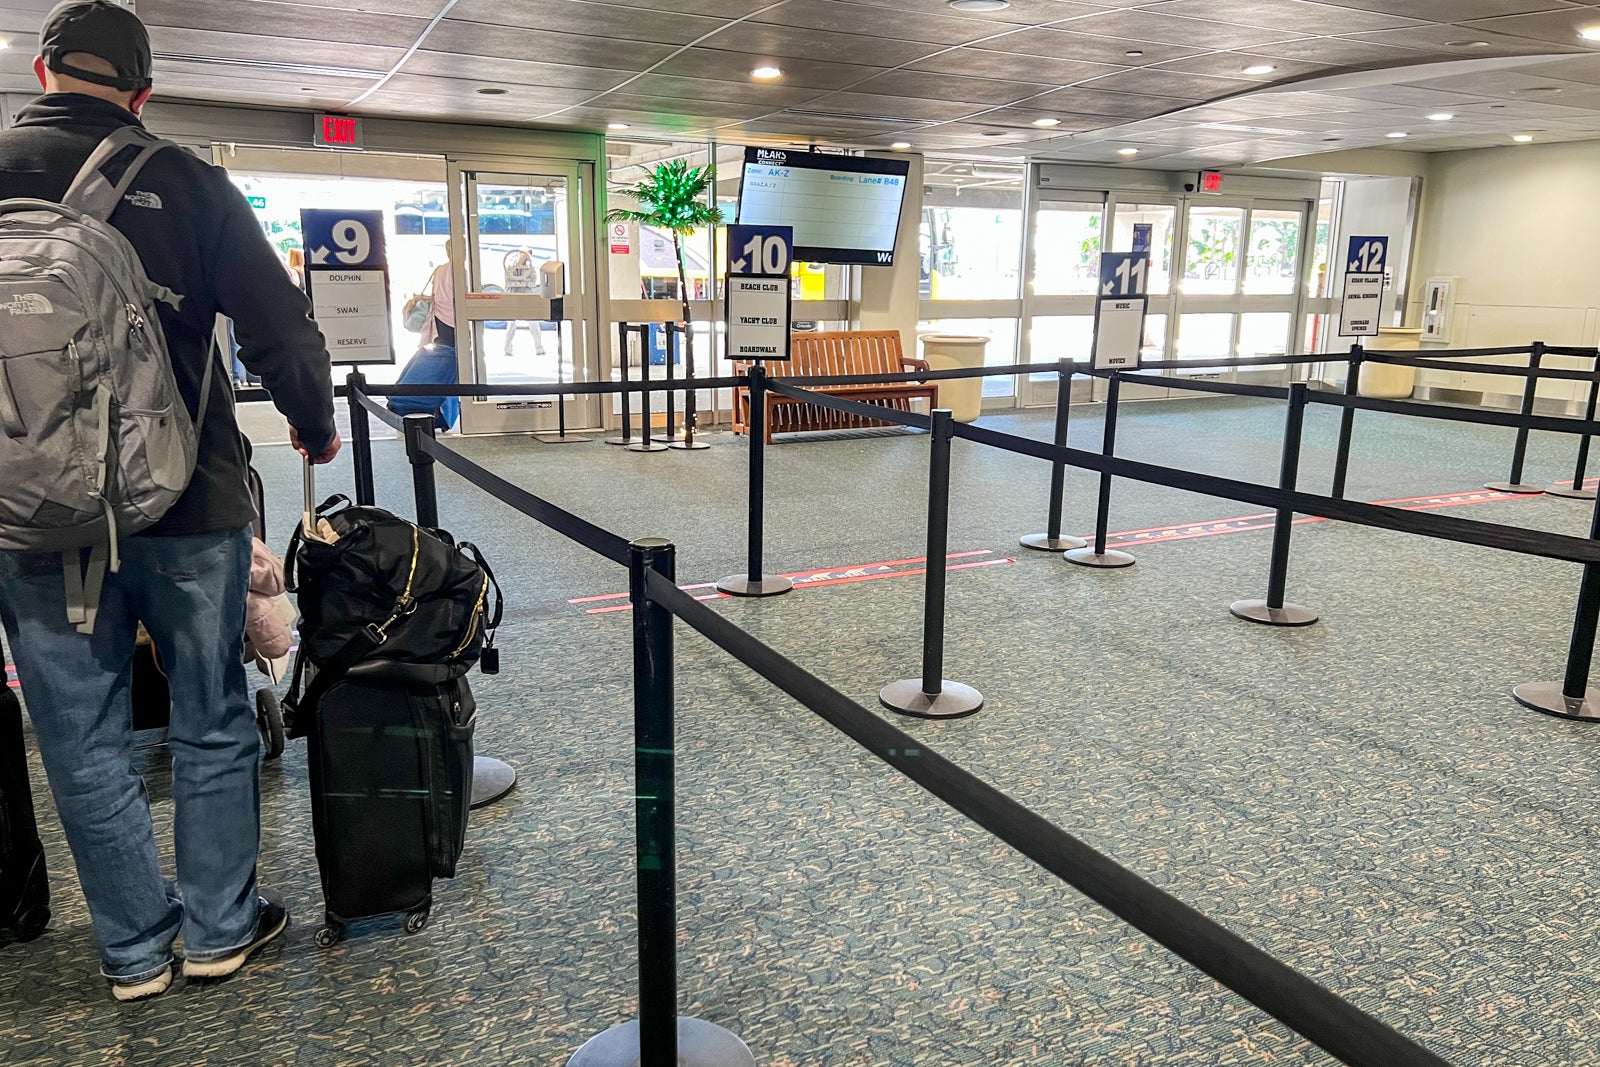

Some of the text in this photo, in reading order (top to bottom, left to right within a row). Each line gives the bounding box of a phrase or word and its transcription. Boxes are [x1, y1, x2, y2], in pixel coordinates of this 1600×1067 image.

[323, 116, 357, 144] EXIT
[757, 149, 787, 160] MEARS
[768, 168, 790, 177] AK-Z
[859, 175, 882, 184] Lane#
[884, 177, 899, 186] B48
[252, 198, 265, 207] 46
[332, 219, 370, 264] 9
[743, 234, 787, 274] 10
[1358, 241, 1383, 272] 12
[329, 274, 361, 282] DOLPHIN
[1115, 258, 1146, 294] 11
[740, 283, 779, 292] BEACH CLUB
[12, 293, 33, 301] THE
[10, 307, 37, 316] FACE
[740, 316, 778, 325] YACHT CLUB
